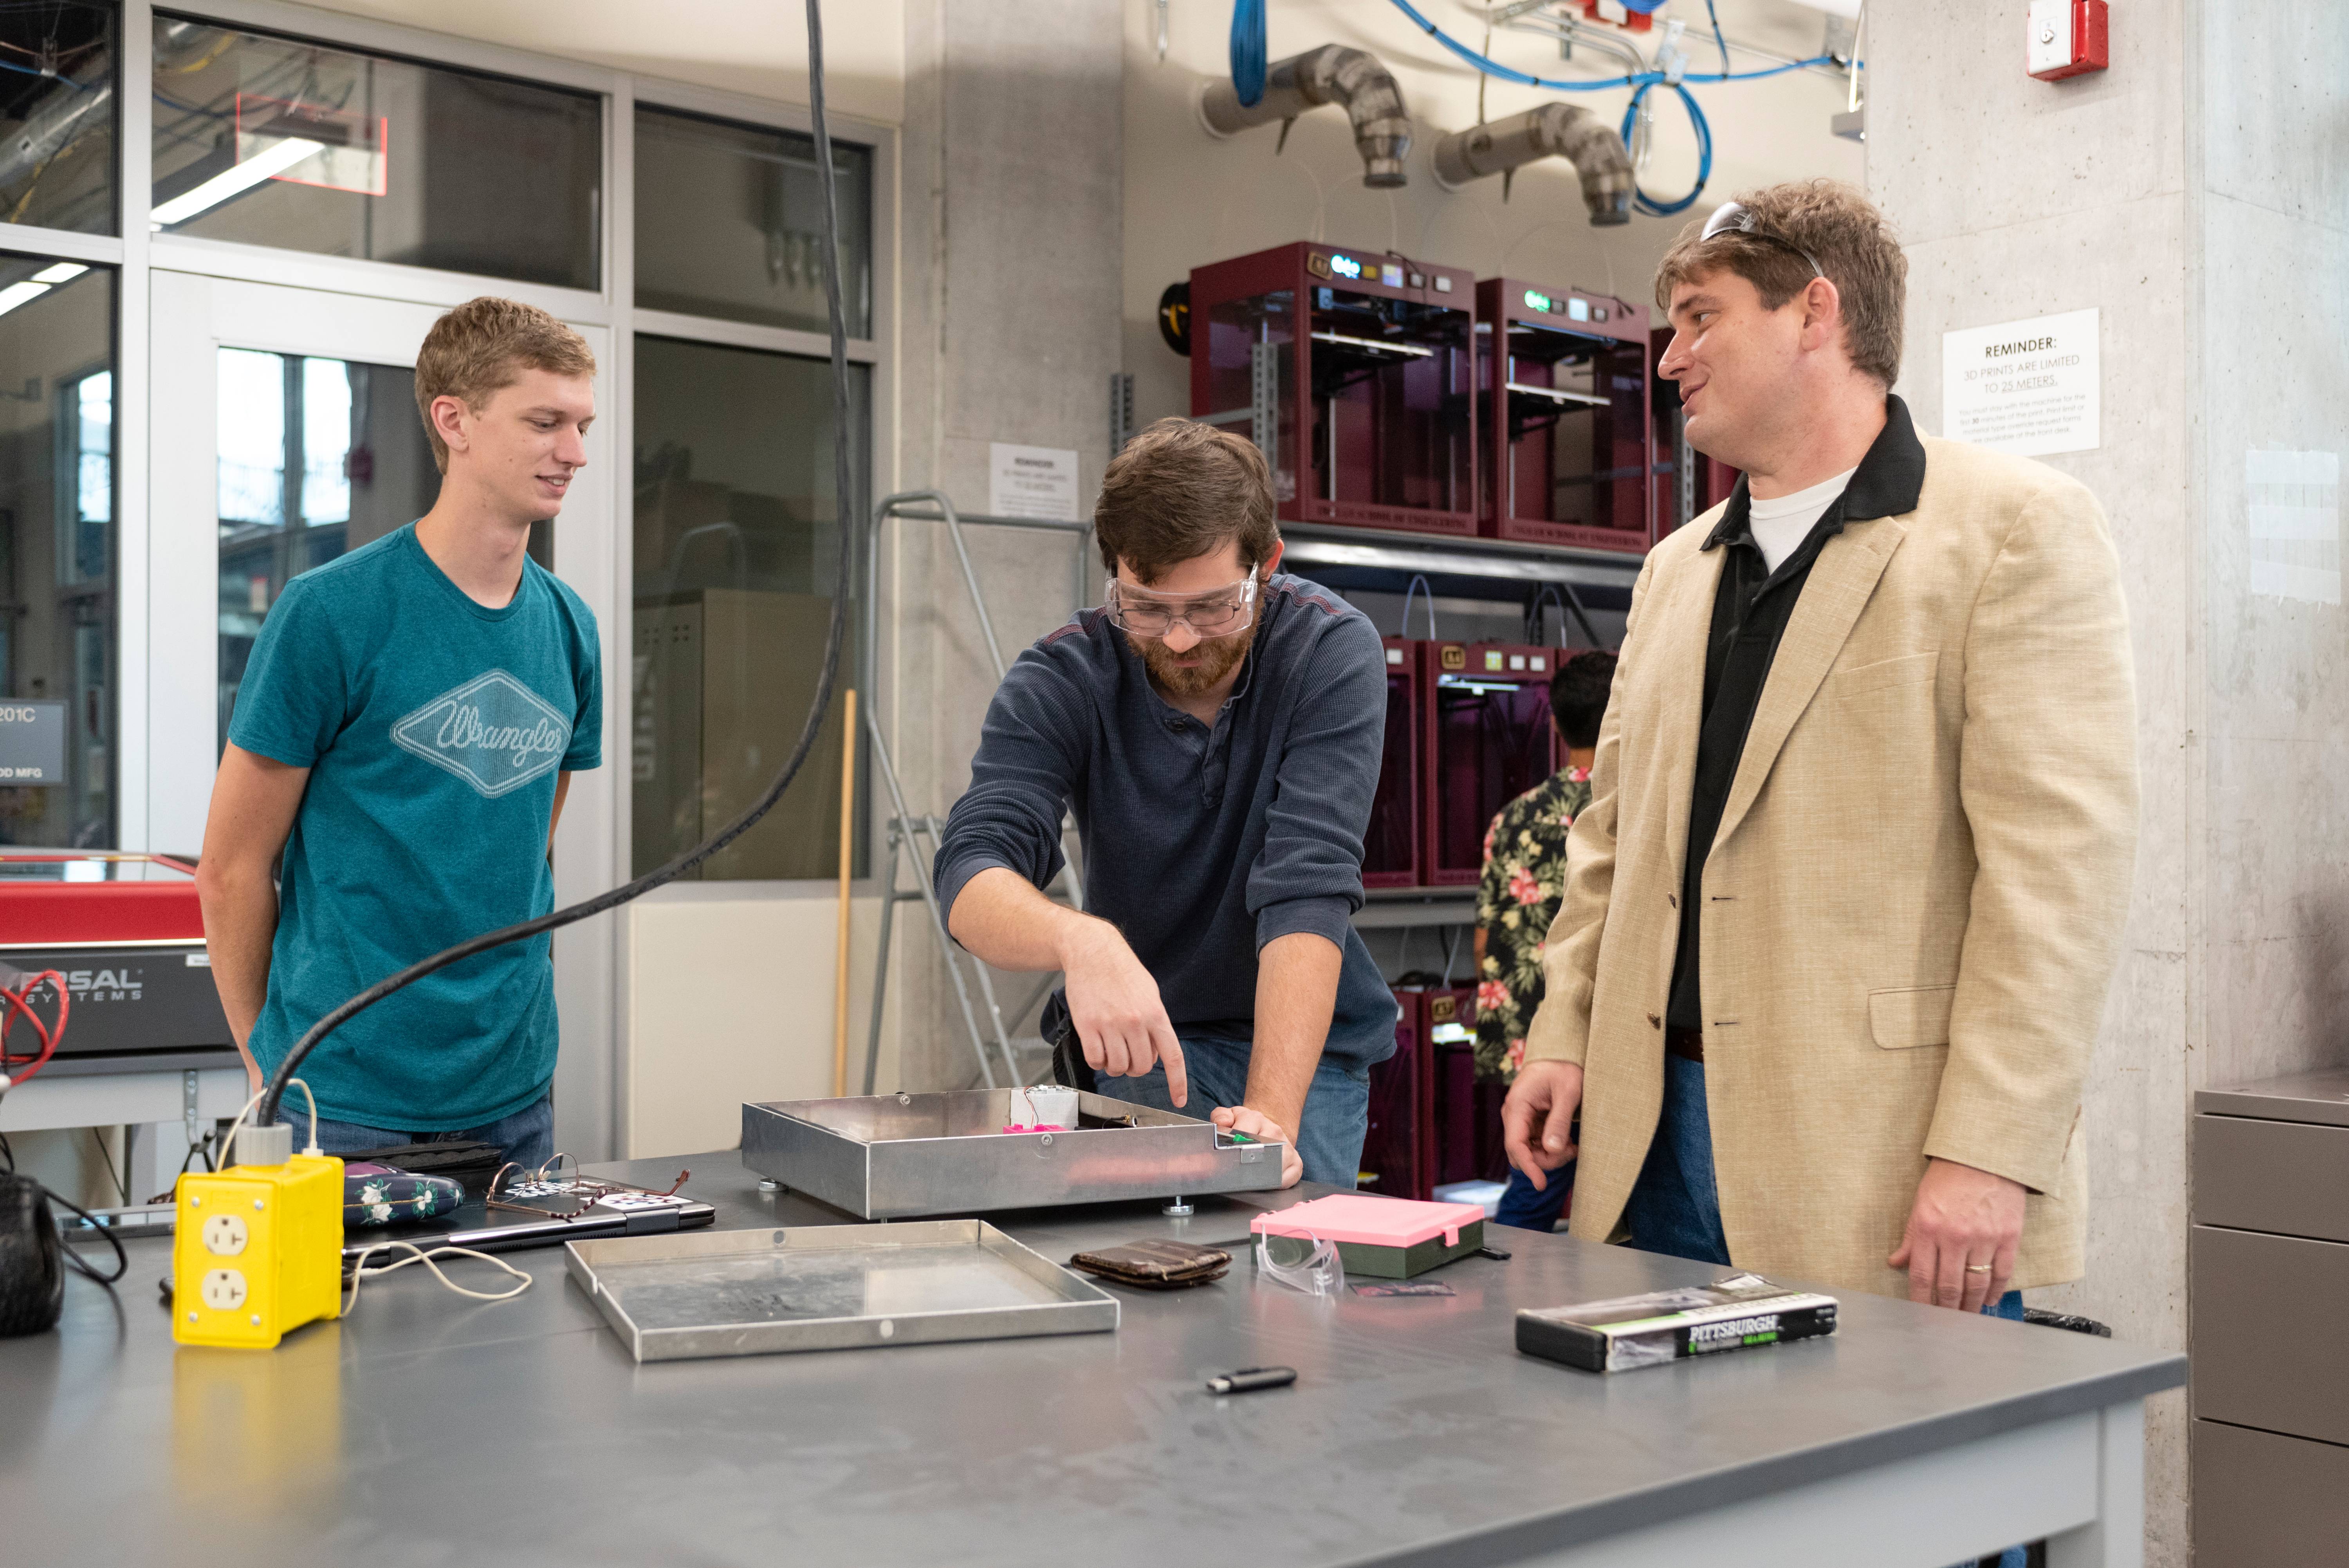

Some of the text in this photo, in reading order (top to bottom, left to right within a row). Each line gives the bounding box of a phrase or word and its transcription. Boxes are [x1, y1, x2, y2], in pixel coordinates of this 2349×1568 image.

[1986, 337, 2057, 358] REMINDER:
[1964, 354, 2080, 381] 3D PRINTS ARE LIMITED
[1985, 375, 2058, 393] TO 25 METERS.
[2031, 397, 2062, 406] machine
[1963, 415, 2081, 435] material type override request forms
[1984, 433, 2014, 443] available
[437, 700, 562, 768] Wrangler
[15, 767, 43, 779] MFG
[25, 990, 142, 1004] SYTEMS
[1689, 1314, 1779, 1342] PITTSBURGH
